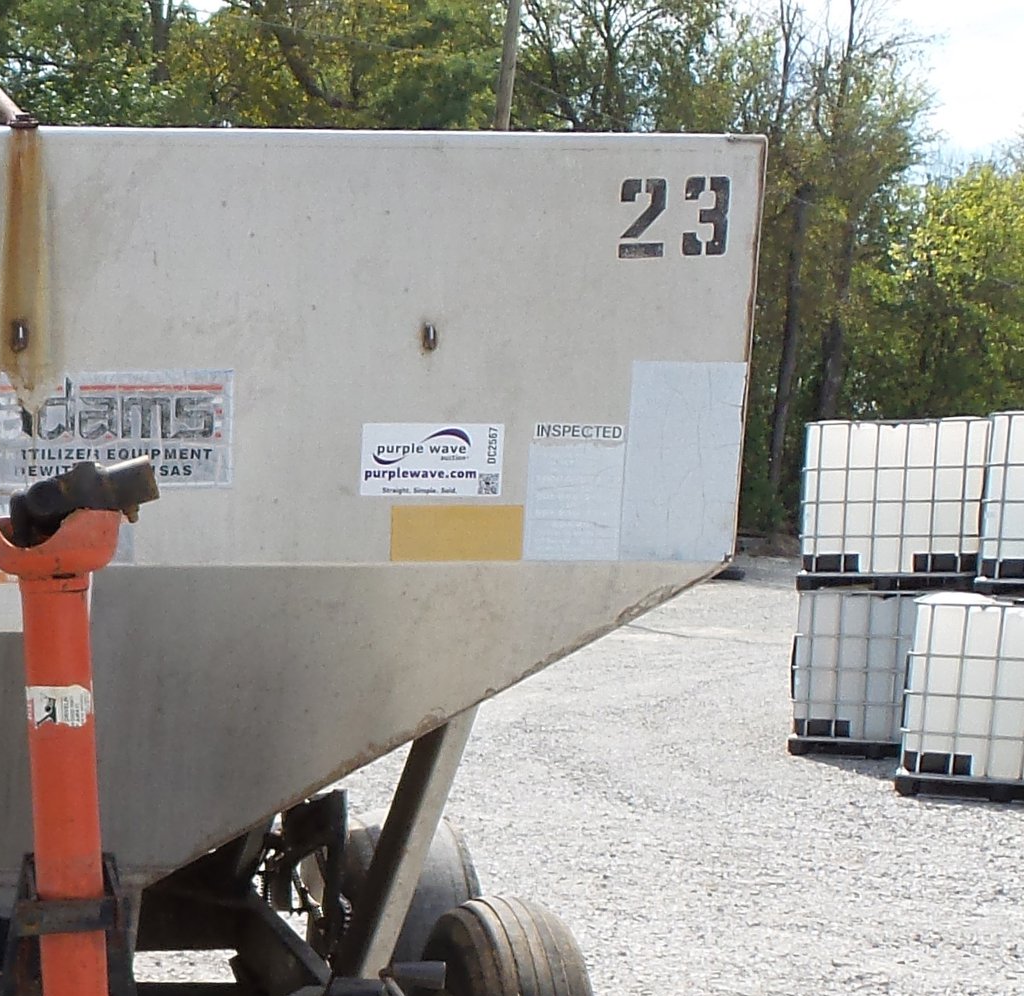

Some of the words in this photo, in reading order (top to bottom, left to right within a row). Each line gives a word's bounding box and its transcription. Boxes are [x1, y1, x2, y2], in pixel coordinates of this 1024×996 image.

[618, 176, 729, 258] 23
[536, 424, 623, 439] INSPECTED
[377, 443, 424, 456] purple
[429, 445, 467, 454] wave
[364, 467, 477, 481] purplewave.com
